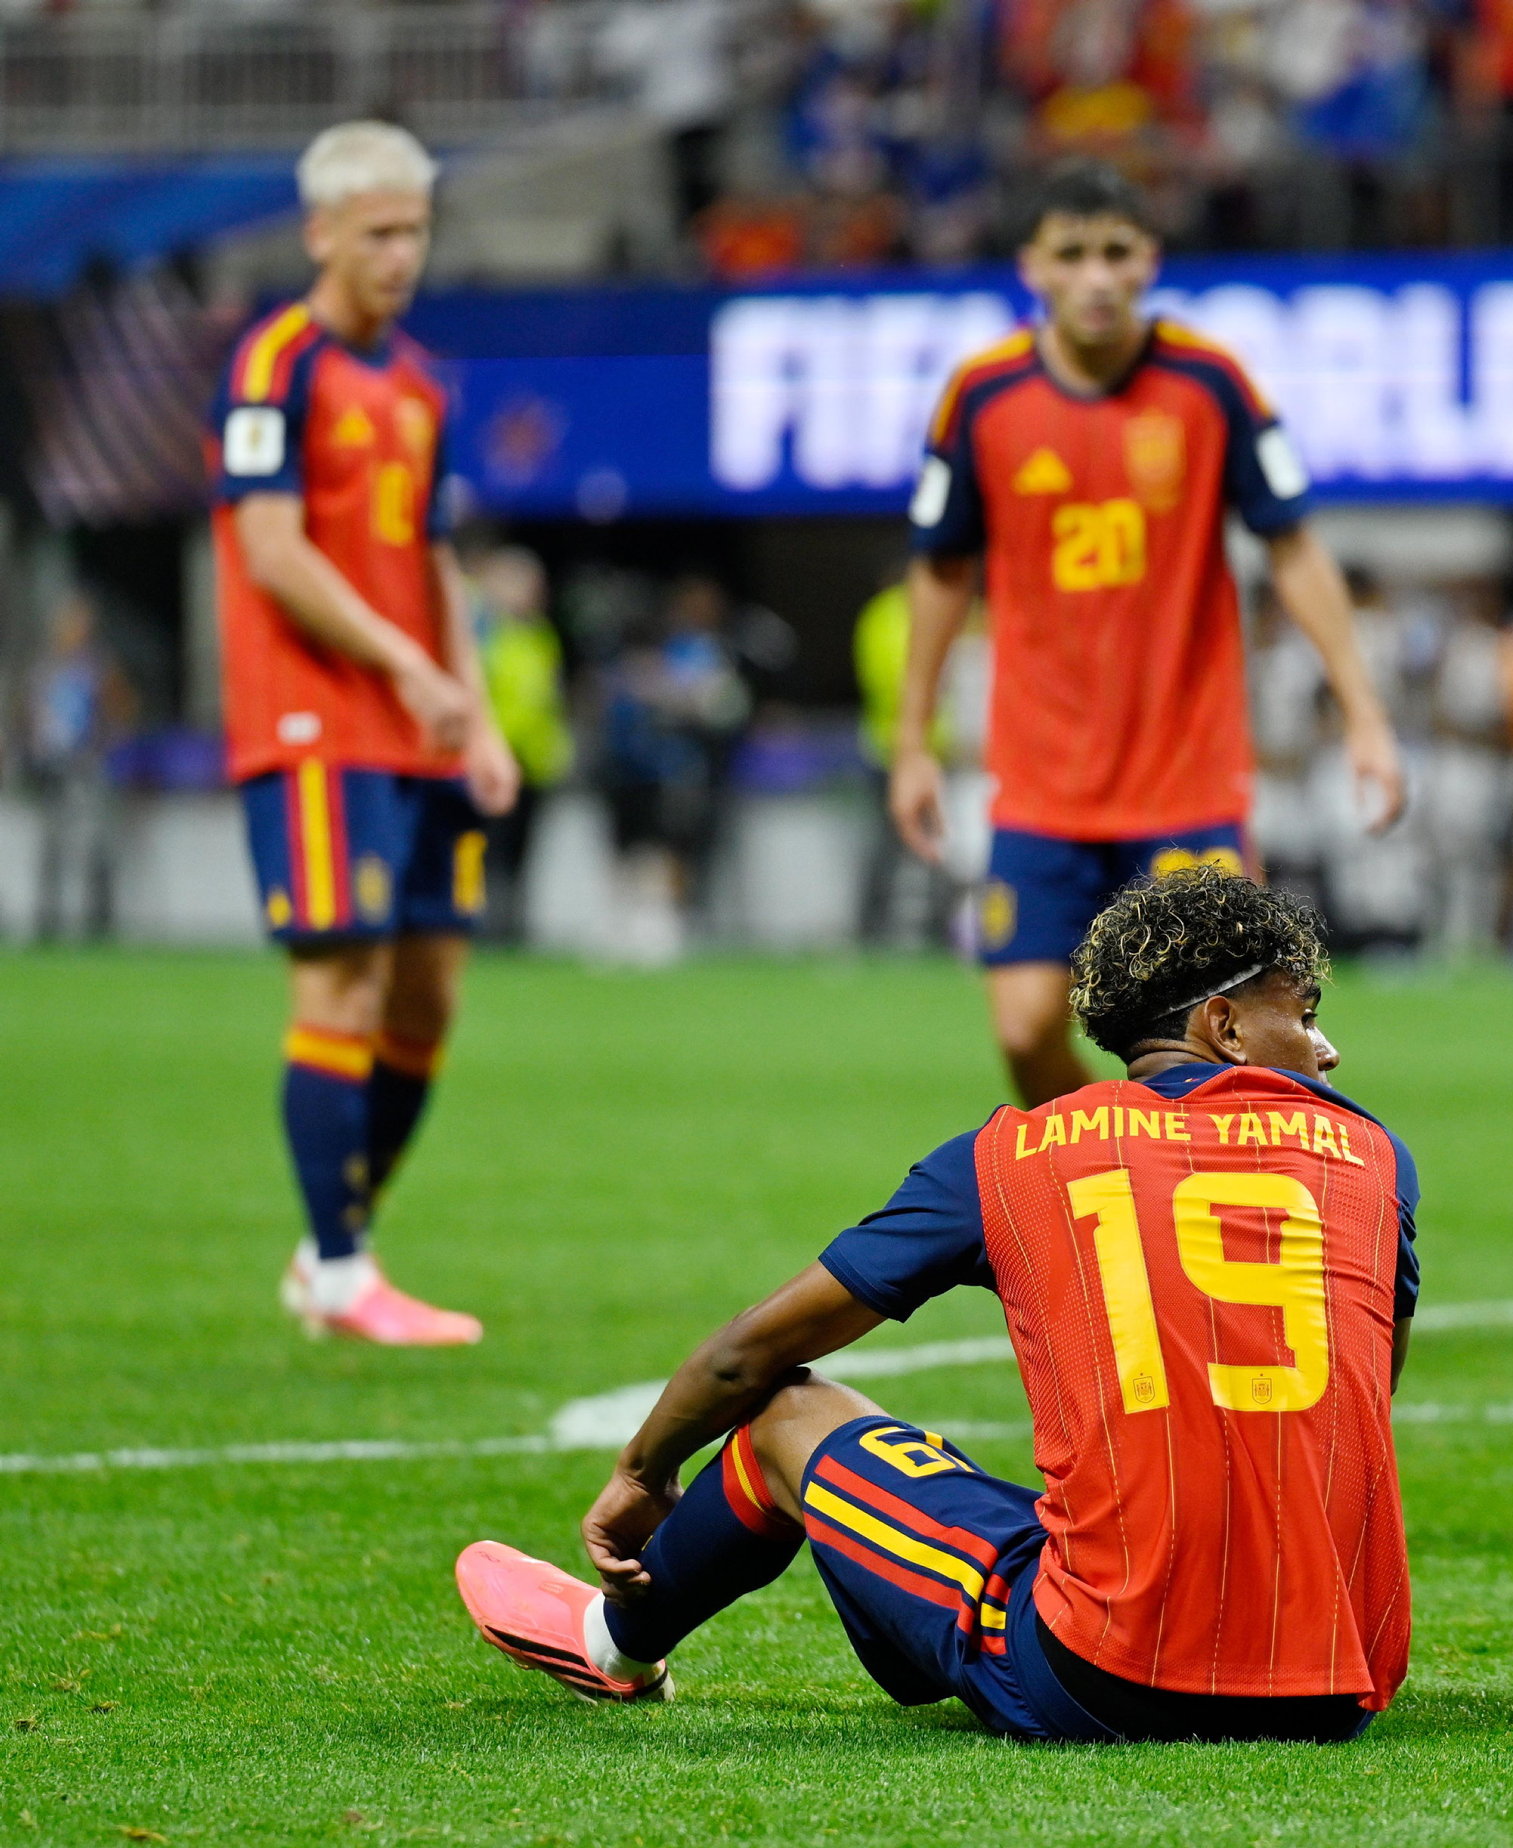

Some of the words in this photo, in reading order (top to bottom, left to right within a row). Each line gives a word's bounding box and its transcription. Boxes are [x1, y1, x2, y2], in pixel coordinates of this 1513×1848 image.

[1052, 499, 1146, 592] 20
[1015, 1105, 1191, 1160] LAMINE
[1208, 1111, 1366, 1168] YAMAL
[1067, 1168, 1330, 1414] 19
